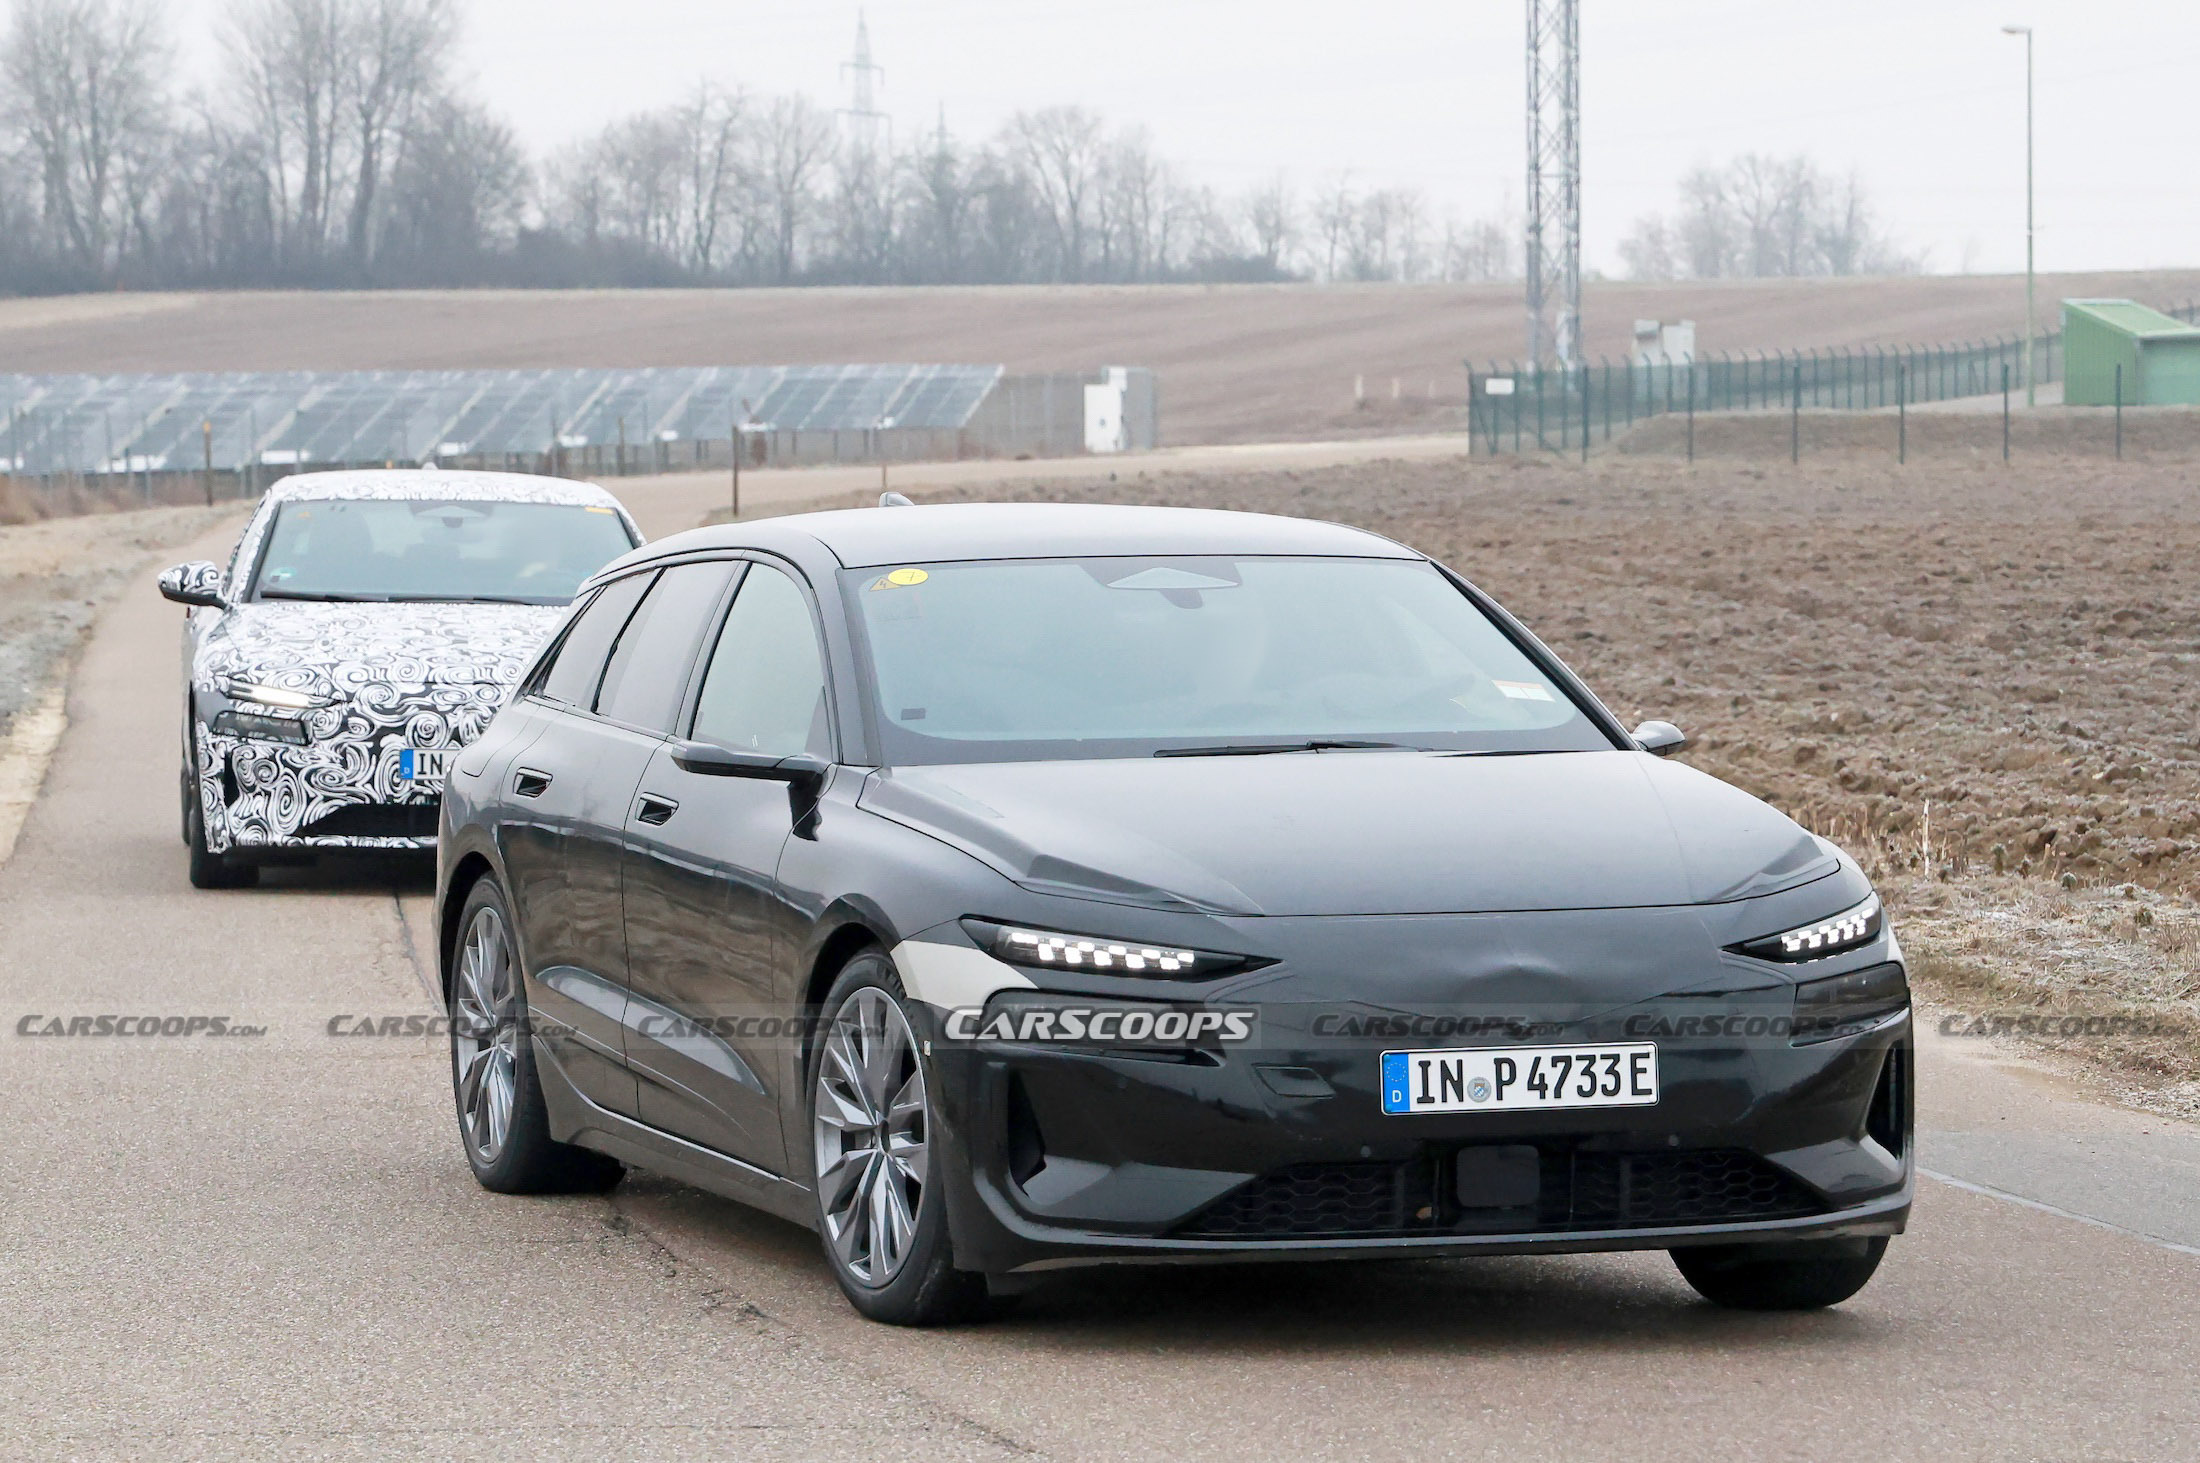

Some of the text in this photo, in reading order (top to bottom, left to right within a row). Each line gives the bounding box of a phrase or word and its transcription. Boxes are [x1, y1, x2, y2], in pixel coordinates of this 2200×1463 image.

[417, 753, 442, 775] IN
[1416, 1052, 1653, 1104] IN P 4733E
[1392, 1090, 1402, 1103] D
